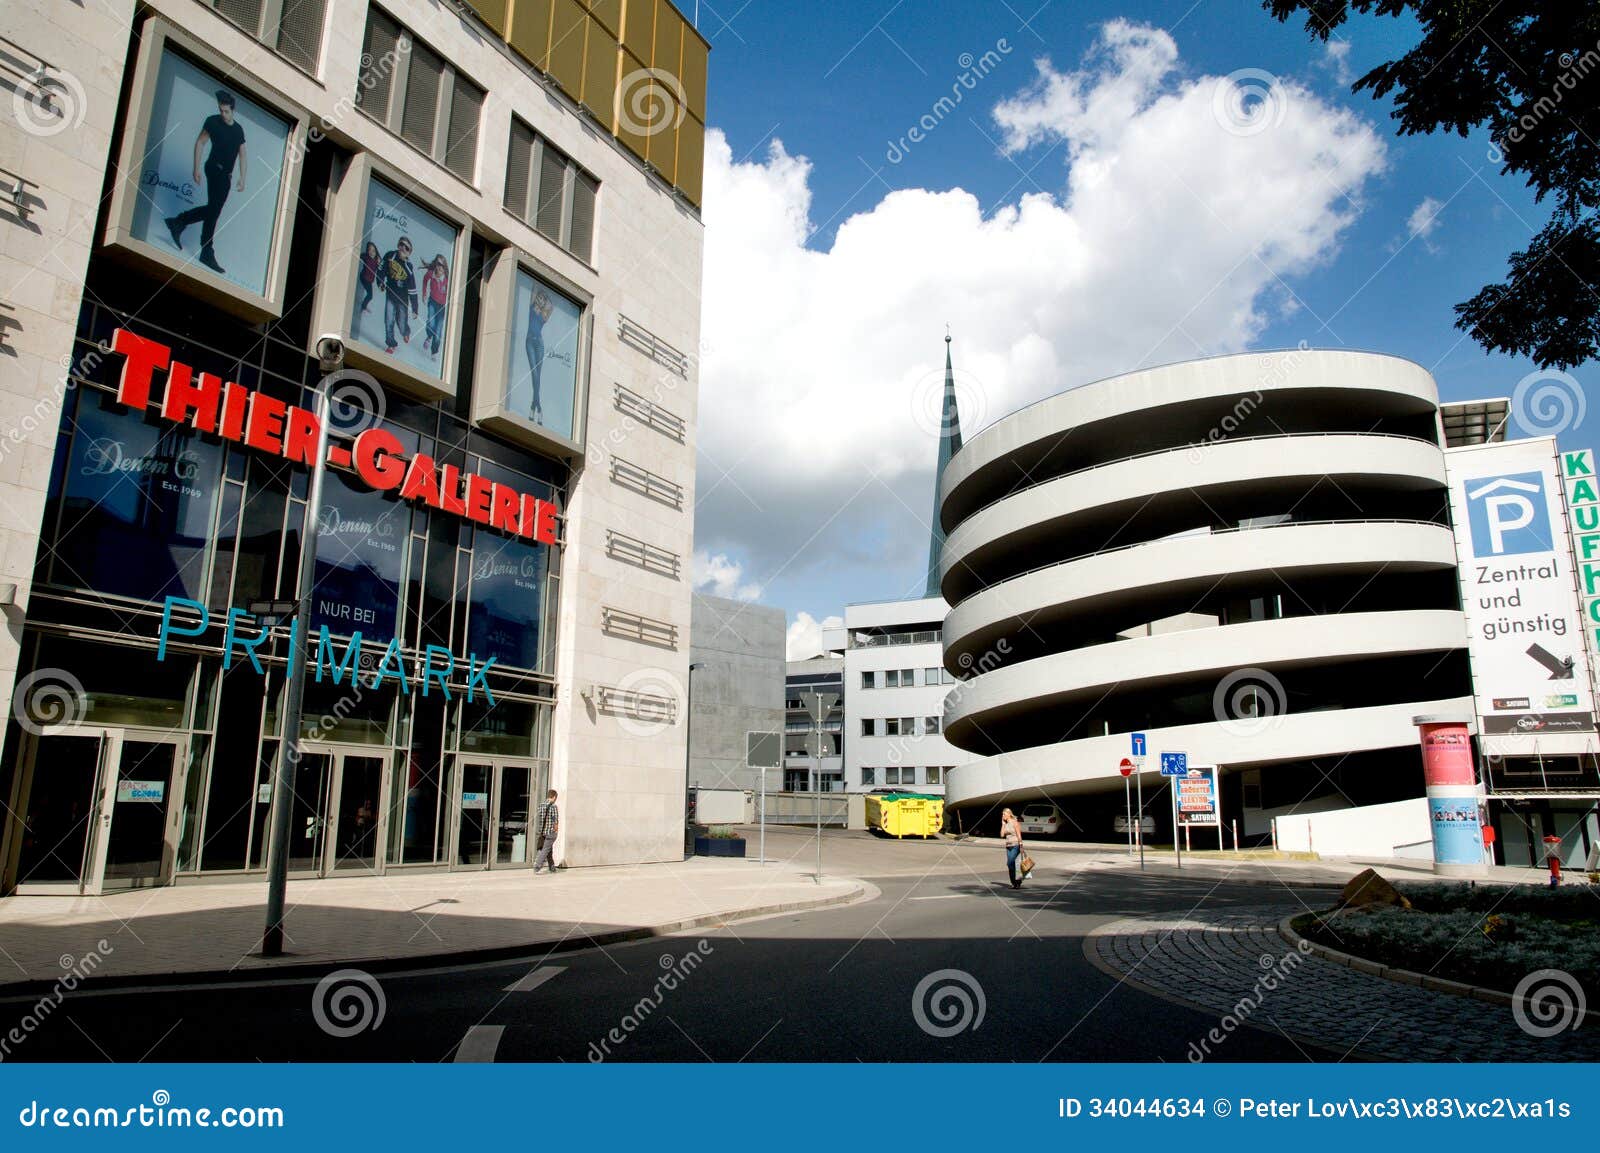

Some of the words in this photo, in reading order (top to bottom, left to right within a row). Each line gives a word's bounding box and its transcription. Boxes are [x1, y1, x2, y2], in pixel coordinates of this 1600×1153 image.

[81, 437, 169, 476] Denim
[162, 480, 180, 493] Est.
[181, 486, 202, 499] 1969
[317, 505, 374, 538] Denim
[1485, 494, 1535, 554] P
[1476, 558, 1559, 585] Zentral
[320, 601, 350, 620] NUR
[353, 606, 375, 624] BEI
[1480, 588, 1521, 610] und
[1483, 613, 1567, 641] günstig
[157, 595, 498, 708] PRIMARK
[1190, 813, 1217, 822] SATURN
